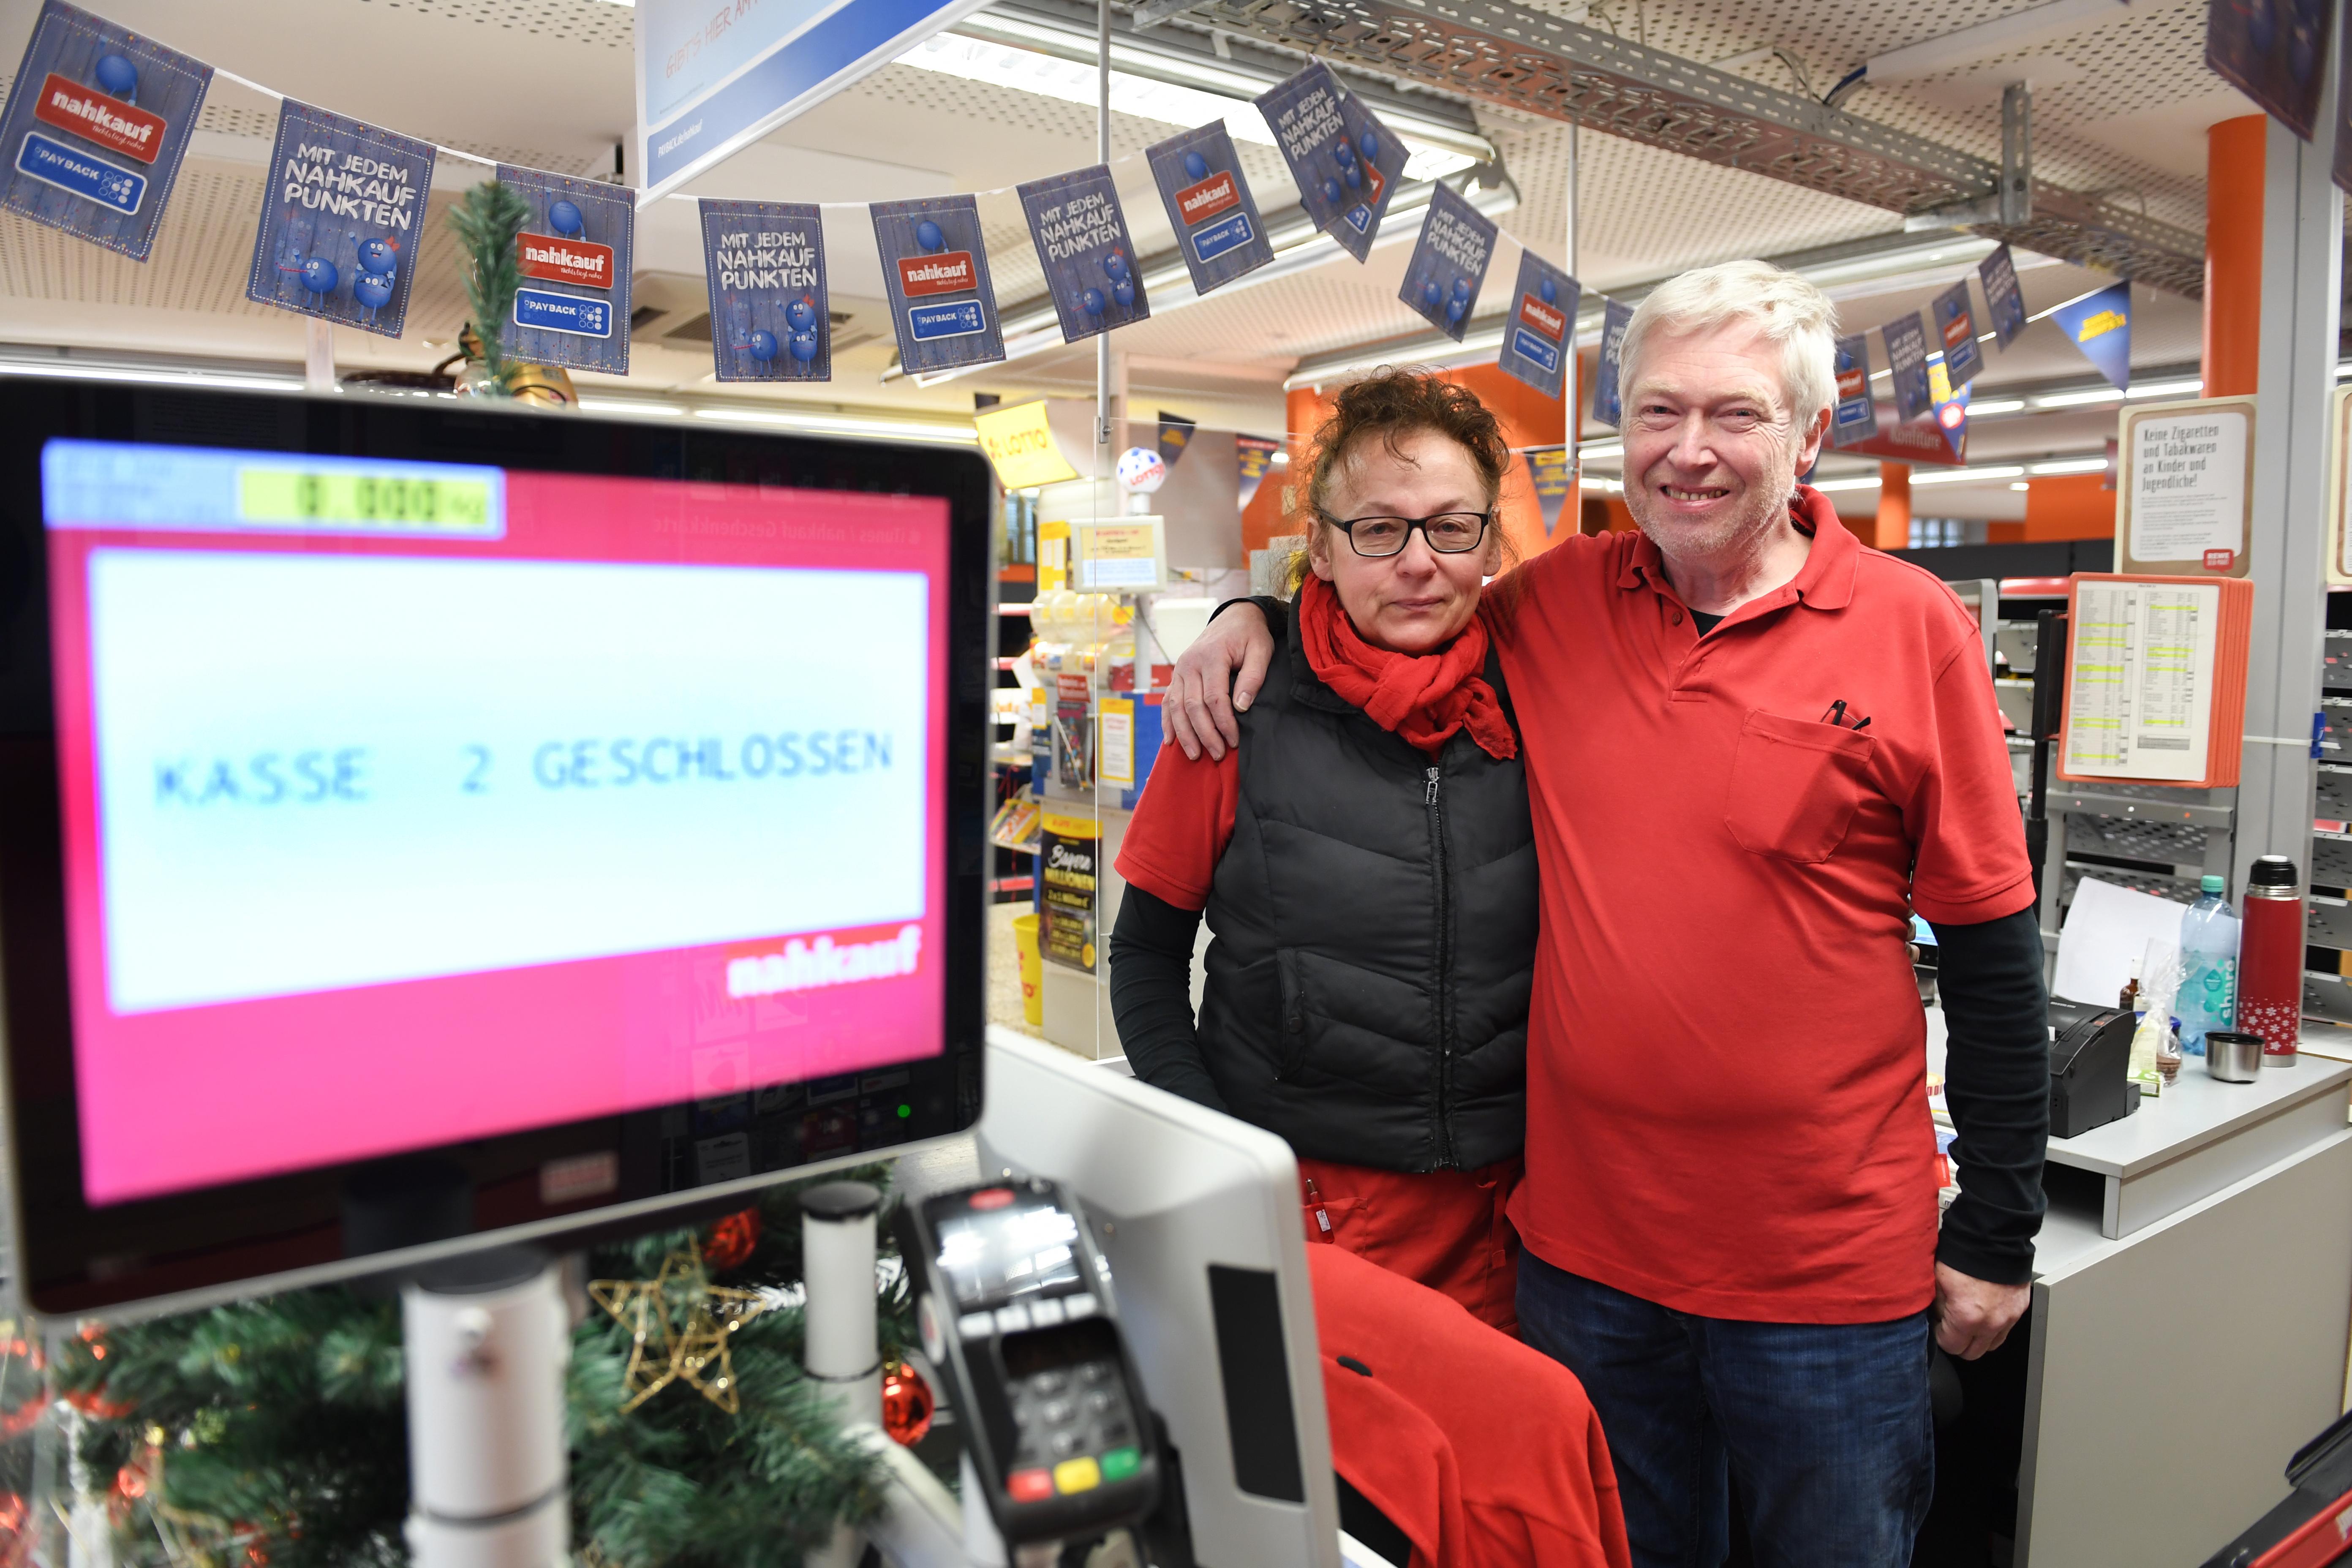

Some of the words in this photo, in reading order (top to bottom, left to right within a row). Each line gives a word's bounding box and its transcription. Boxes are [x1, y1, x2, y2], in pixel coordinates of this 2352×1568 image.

[666, 32, 701, 78] GIBT'S
[705, 6, 731, 46] HIER
[51, 91, 153, 143] nahkauf
[1278, 109, 1296, 129] MIT
[1297, 87, 1327, 117] JEDEM
[1281, 96, 1336, 147] NAHKAUF
[1290, 111, 1344, 162] PUNKTEN
[40, 150, 99, 180] PAYBACK
[297, 142, 335, 165] MIT
[339, 154, 408, 184] JEDEM
[285, 159, 416, 206] NAHKAUF
[1184, 179, 1230, 212] nahkauf
[284, 182, 411, 230] PUNKTEN
[1040, 206, 1061, 226] MIT
[1066, 191, 1104, 218] JEDEM
[721, 233, 749, 248] MIT
[754, 231, 805, 248] JEDEM
[1040, 204, 1114, 246] NAHKAUF
[1048, 221, 1121, 263] PUNKTEN
[1202, 229, 1230, 247] PAYBACK
[1429, 216, 1487, 261] NAHKAUF
[1437, 208, 1455, 225] MIT
[1455, 220, 1485, 247] JEDEM
[525, 246, 604, 272] nahkauf
[717, 248, 815, 270] NAHKAUF
[907, 260, 966, 282] nahkauf
[1426, 231, 1482, 276] PUNKTEN
[721, 267, 817, 291] PUNKTEN
[529, 300, 576, 316] PAYBACK
[921, 312, 957, 324] PAYBACK
[1525, 303, 1562, 330] nahkauf
[1003, 429, 1047, 455] LOTTO
[2144, 444, 2159, 458] und
[2164, 442, 2217, 456] Tabakwaren
[2145, 428, 2168, 441] Keine
[2172, 426, 2219, 443] Zigaretten
[2143, 463, 2153, 474] an
[2158, 459, 2185, 473] Kinder
[2190, 456, 2206, 471] und
[2142, 474, 2197, 493] Jugendliche!
[152, 744, 368, 806] KASSE
[458, 743, 495, 795] 2
[531, 729, 893, 791] GESCHLOSSEN
[727, 923, 923, 999] nahkauf
[2219, 959, 2235, 1019] share
